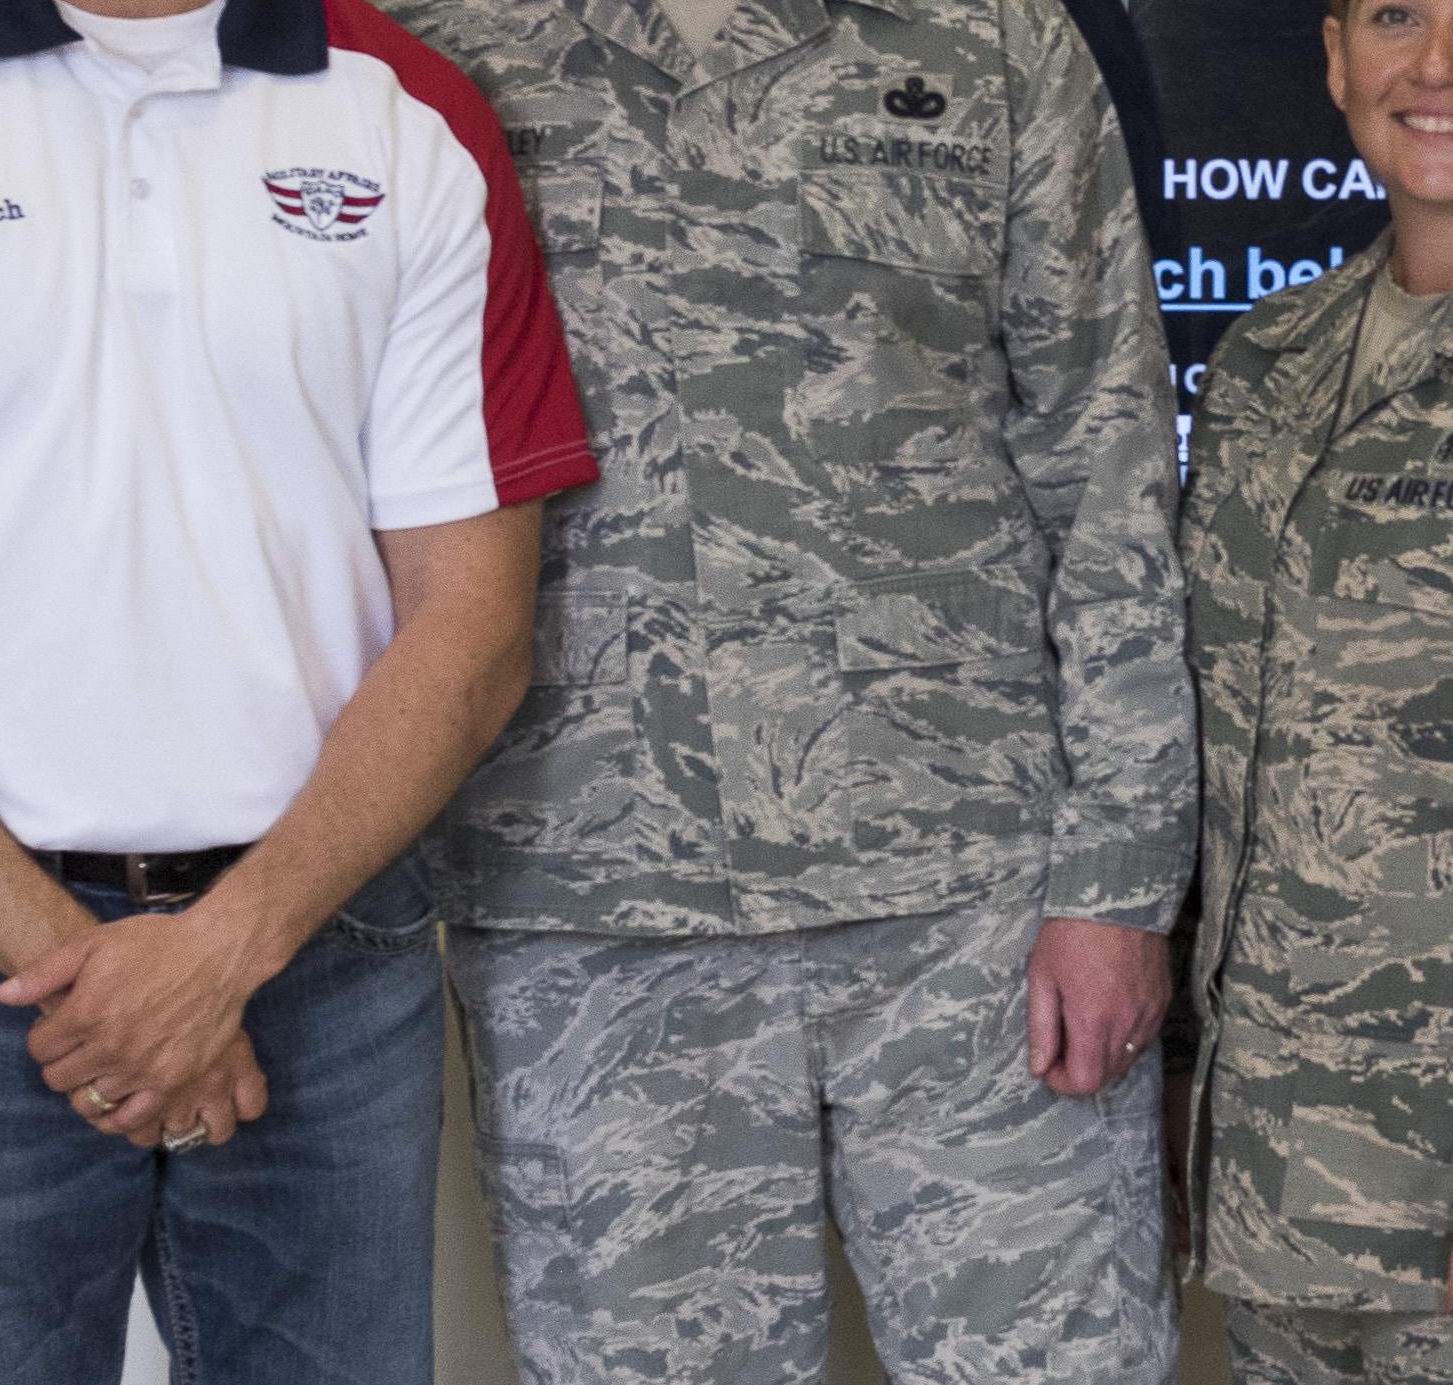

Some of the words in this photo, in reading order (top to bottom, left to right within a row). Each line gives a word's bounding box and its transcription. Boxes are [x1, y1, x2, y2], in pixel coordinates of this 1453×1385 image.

[869, 137, 912, 166] AIR
[916, 141, 993, 175] FORCE
[1164, 158, 1289, 200] HOW
[1384, 478, 1430, 506] AIR
